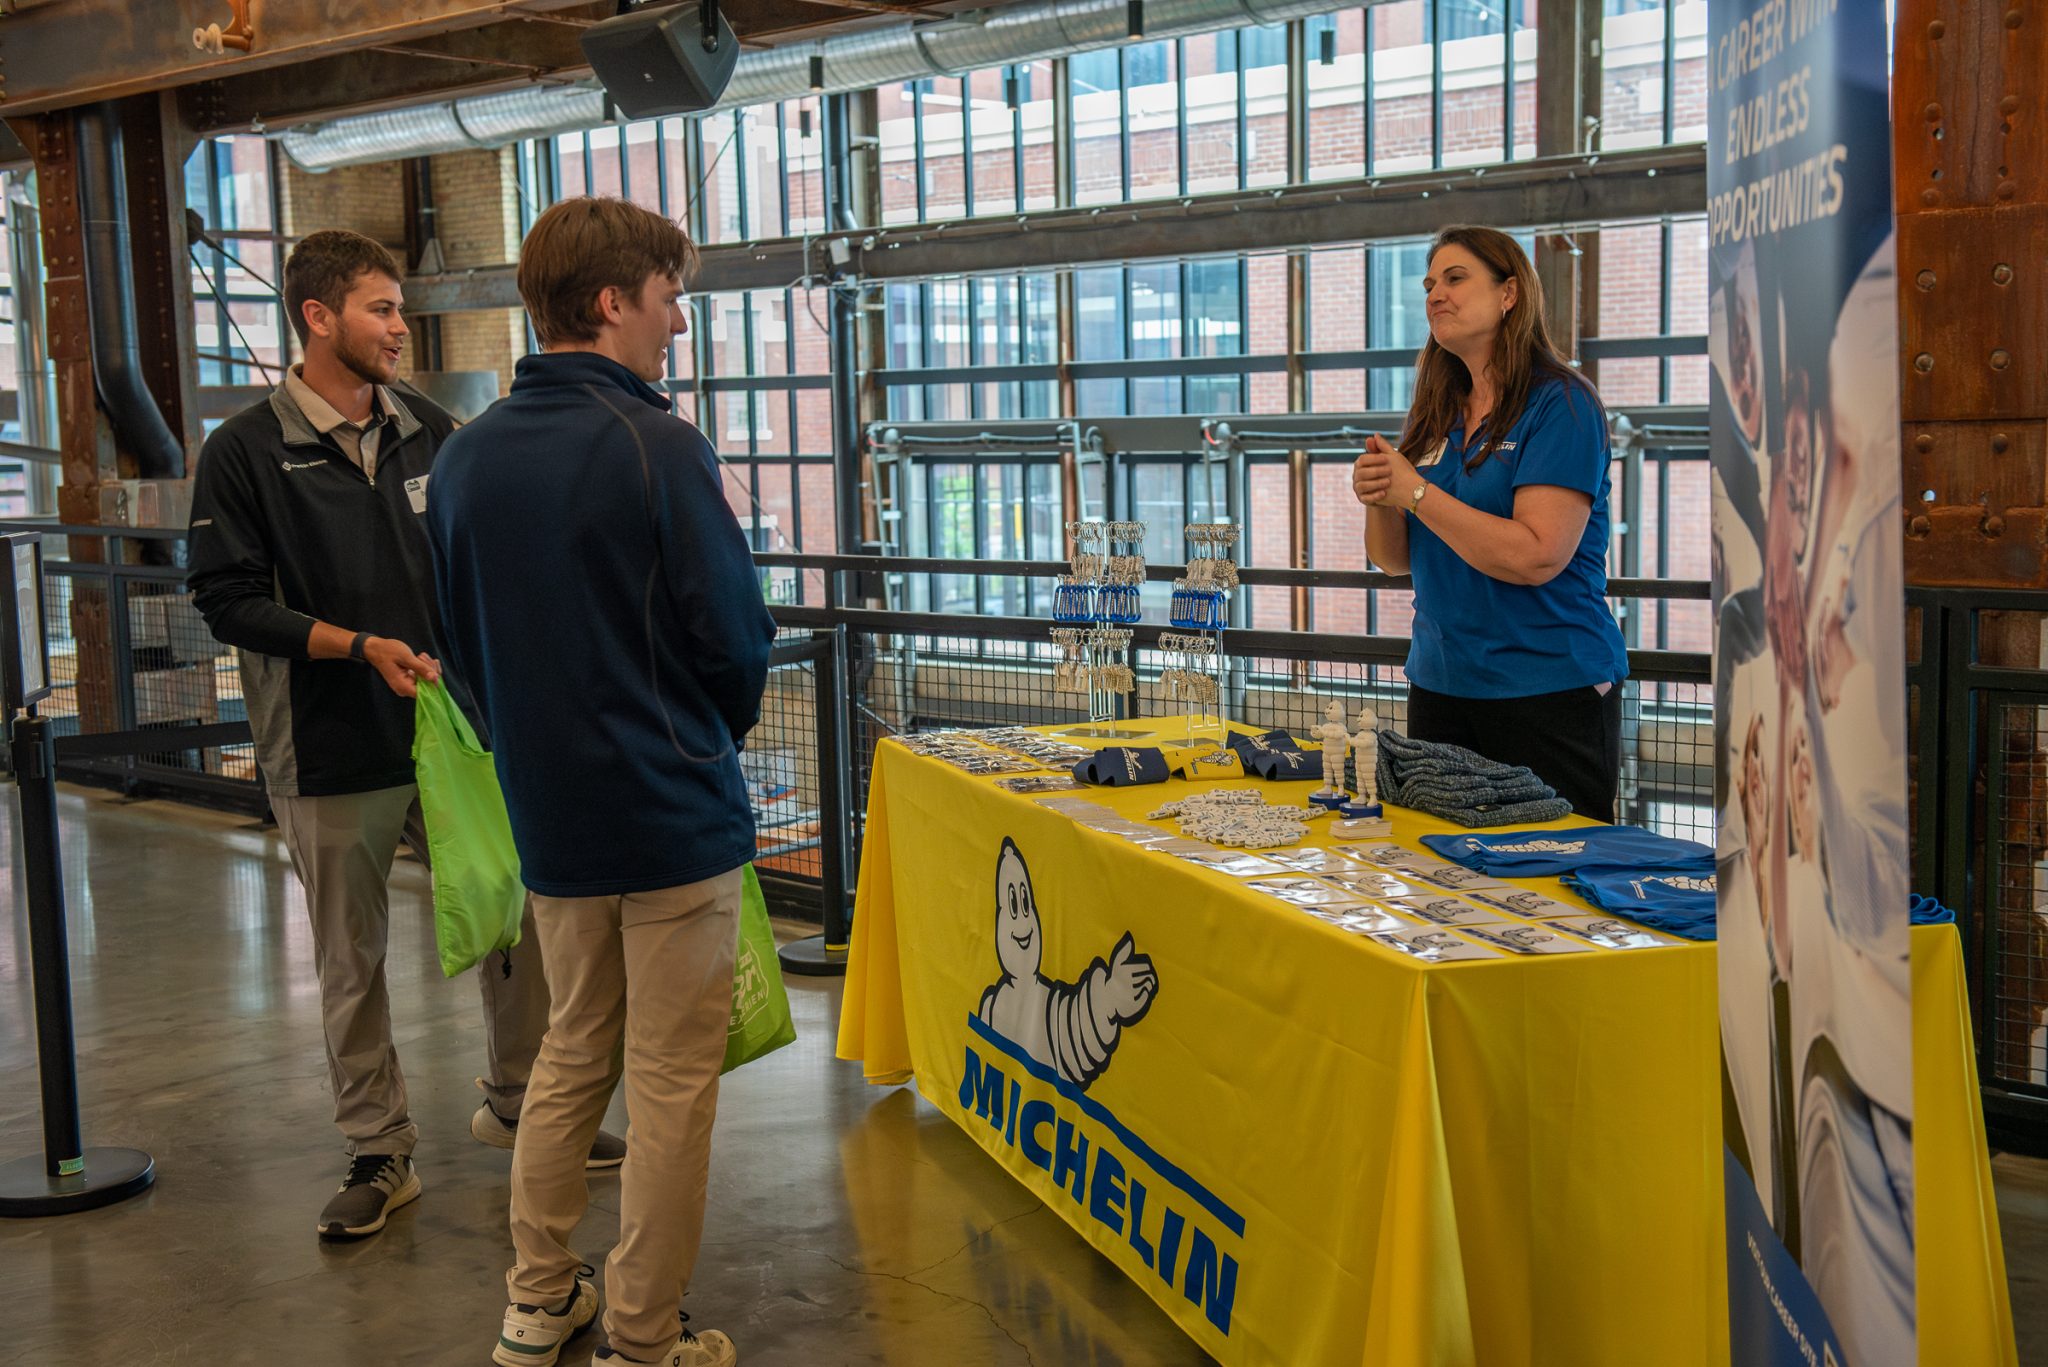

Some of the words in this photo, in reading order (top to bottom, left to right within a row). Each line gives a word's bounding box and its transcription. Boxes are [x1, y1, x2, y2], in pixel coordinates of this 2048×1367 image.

[1718, 0, 1785, 90] CAREER
[1726, 64, 1811, 165] ENDLESS
[959, 1044, 1240, 1337] MICHELIN
